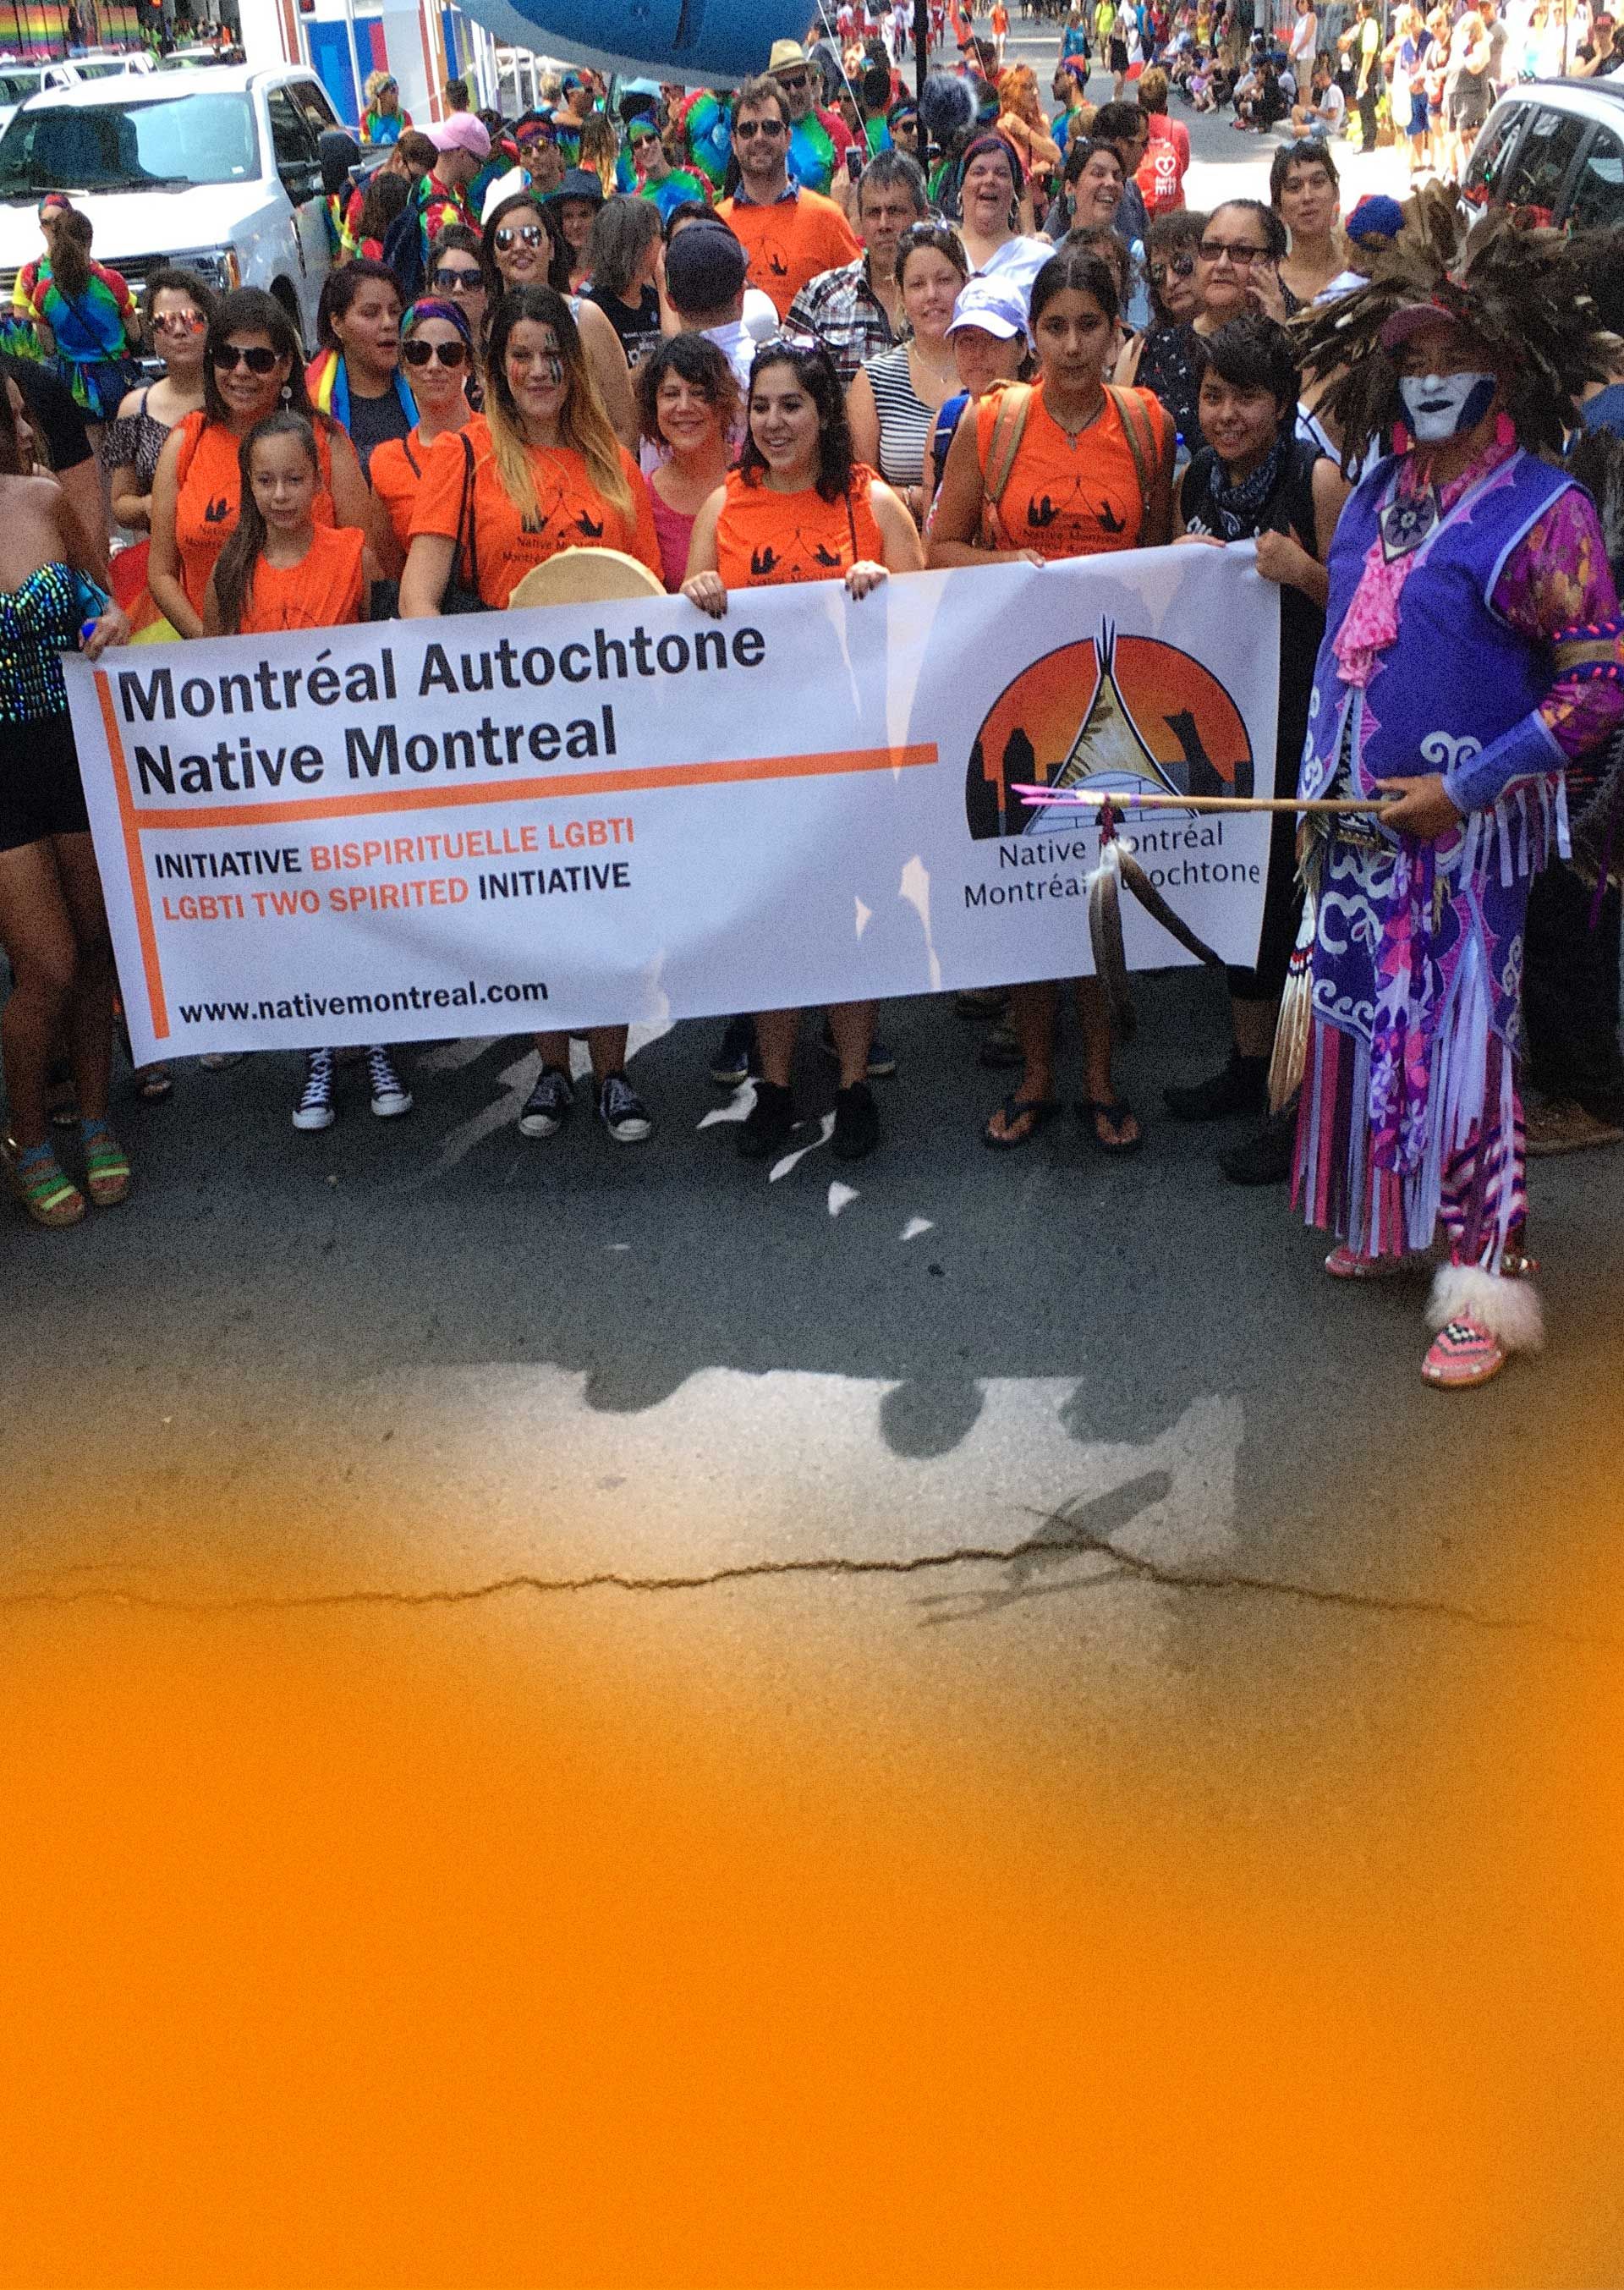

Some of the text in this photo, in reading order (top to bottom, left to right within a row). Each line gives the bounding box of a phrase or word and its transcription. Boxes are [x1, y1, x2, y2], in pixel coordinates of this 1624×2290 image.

[118, 626, 765, 722] Montréal Autochtone
[134, 704, 617, 795] Native Montreal
[155, 817, 634, 879] INITIATIVE BISPIRITUELLE LGBTI
[999, 821, 1224, 869] Native ontréal
[1120, 856, 1260, 891] ochtone
[162, 861, 631, 921] LGBTI TWO SPIRITED INITIATIVE
[178, 980, 549, 1024] www.nativemontreal.com
